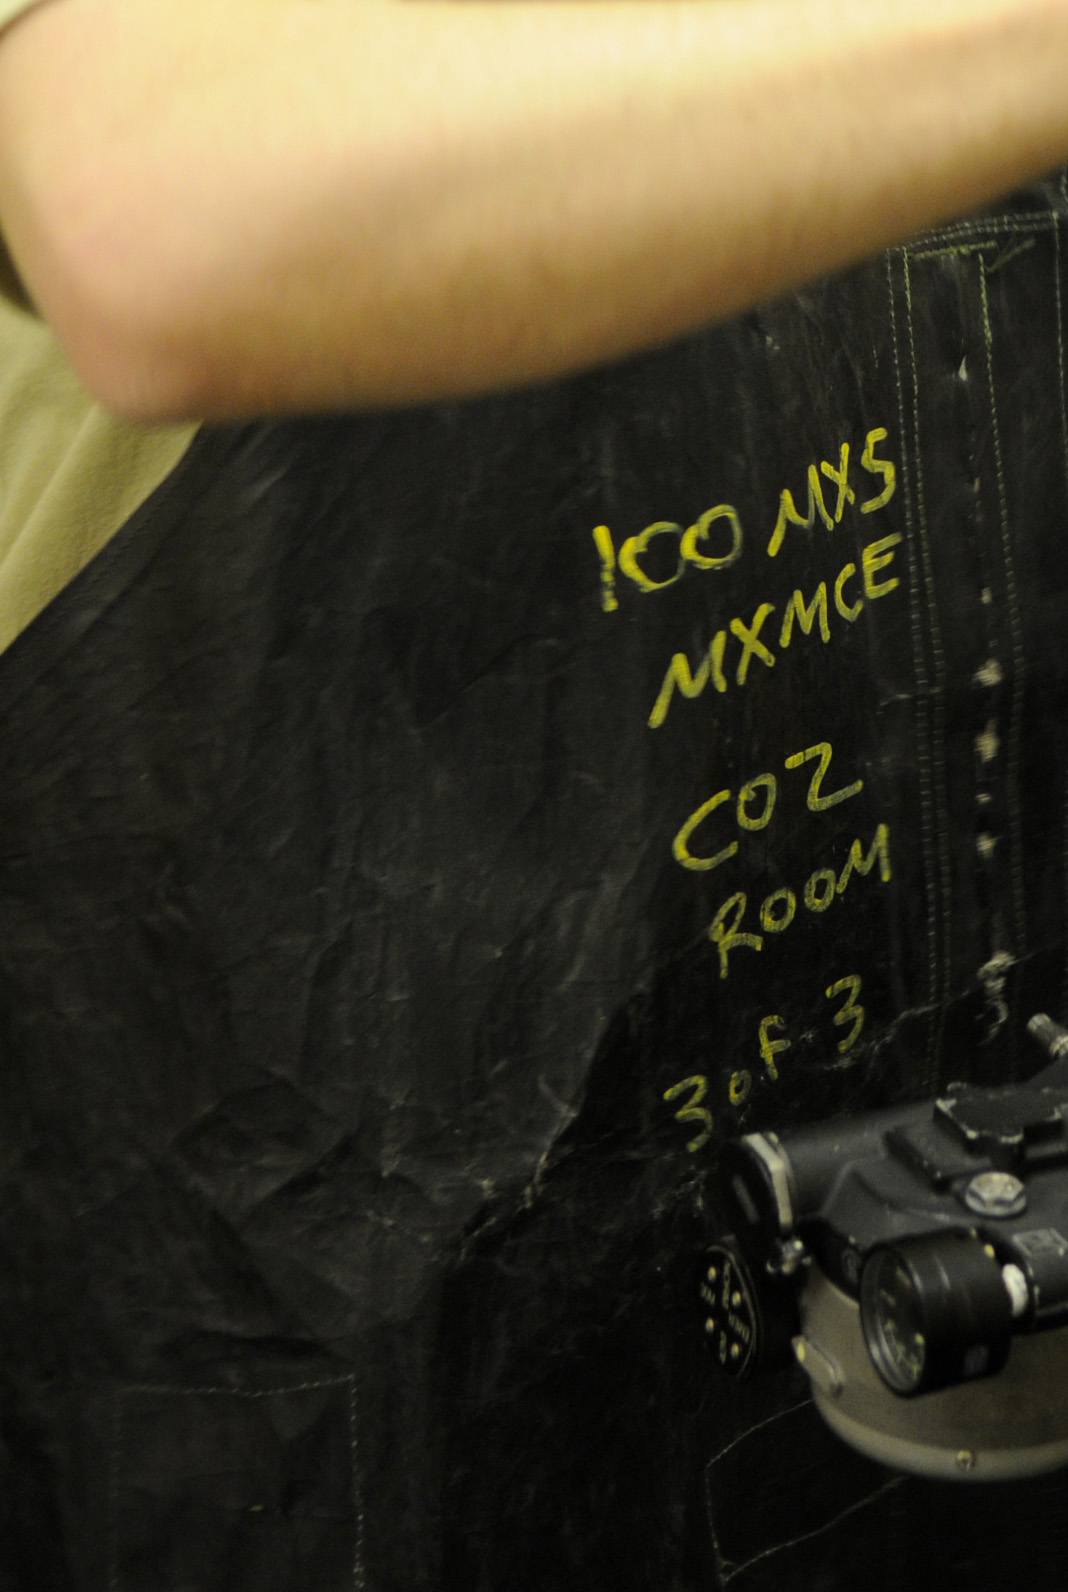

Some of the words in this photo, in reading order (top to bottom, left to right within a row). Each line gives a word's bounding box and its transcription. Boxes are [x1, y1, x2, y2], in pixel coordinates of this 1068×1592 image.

[592, 504, 743, 612] 100
[648, 532, 904, 729] MXMCE
[708, 823, 892, 979] ROOM
[662, 1074, 713, 1152] 3
[825, 974, 864, 1053] 3
